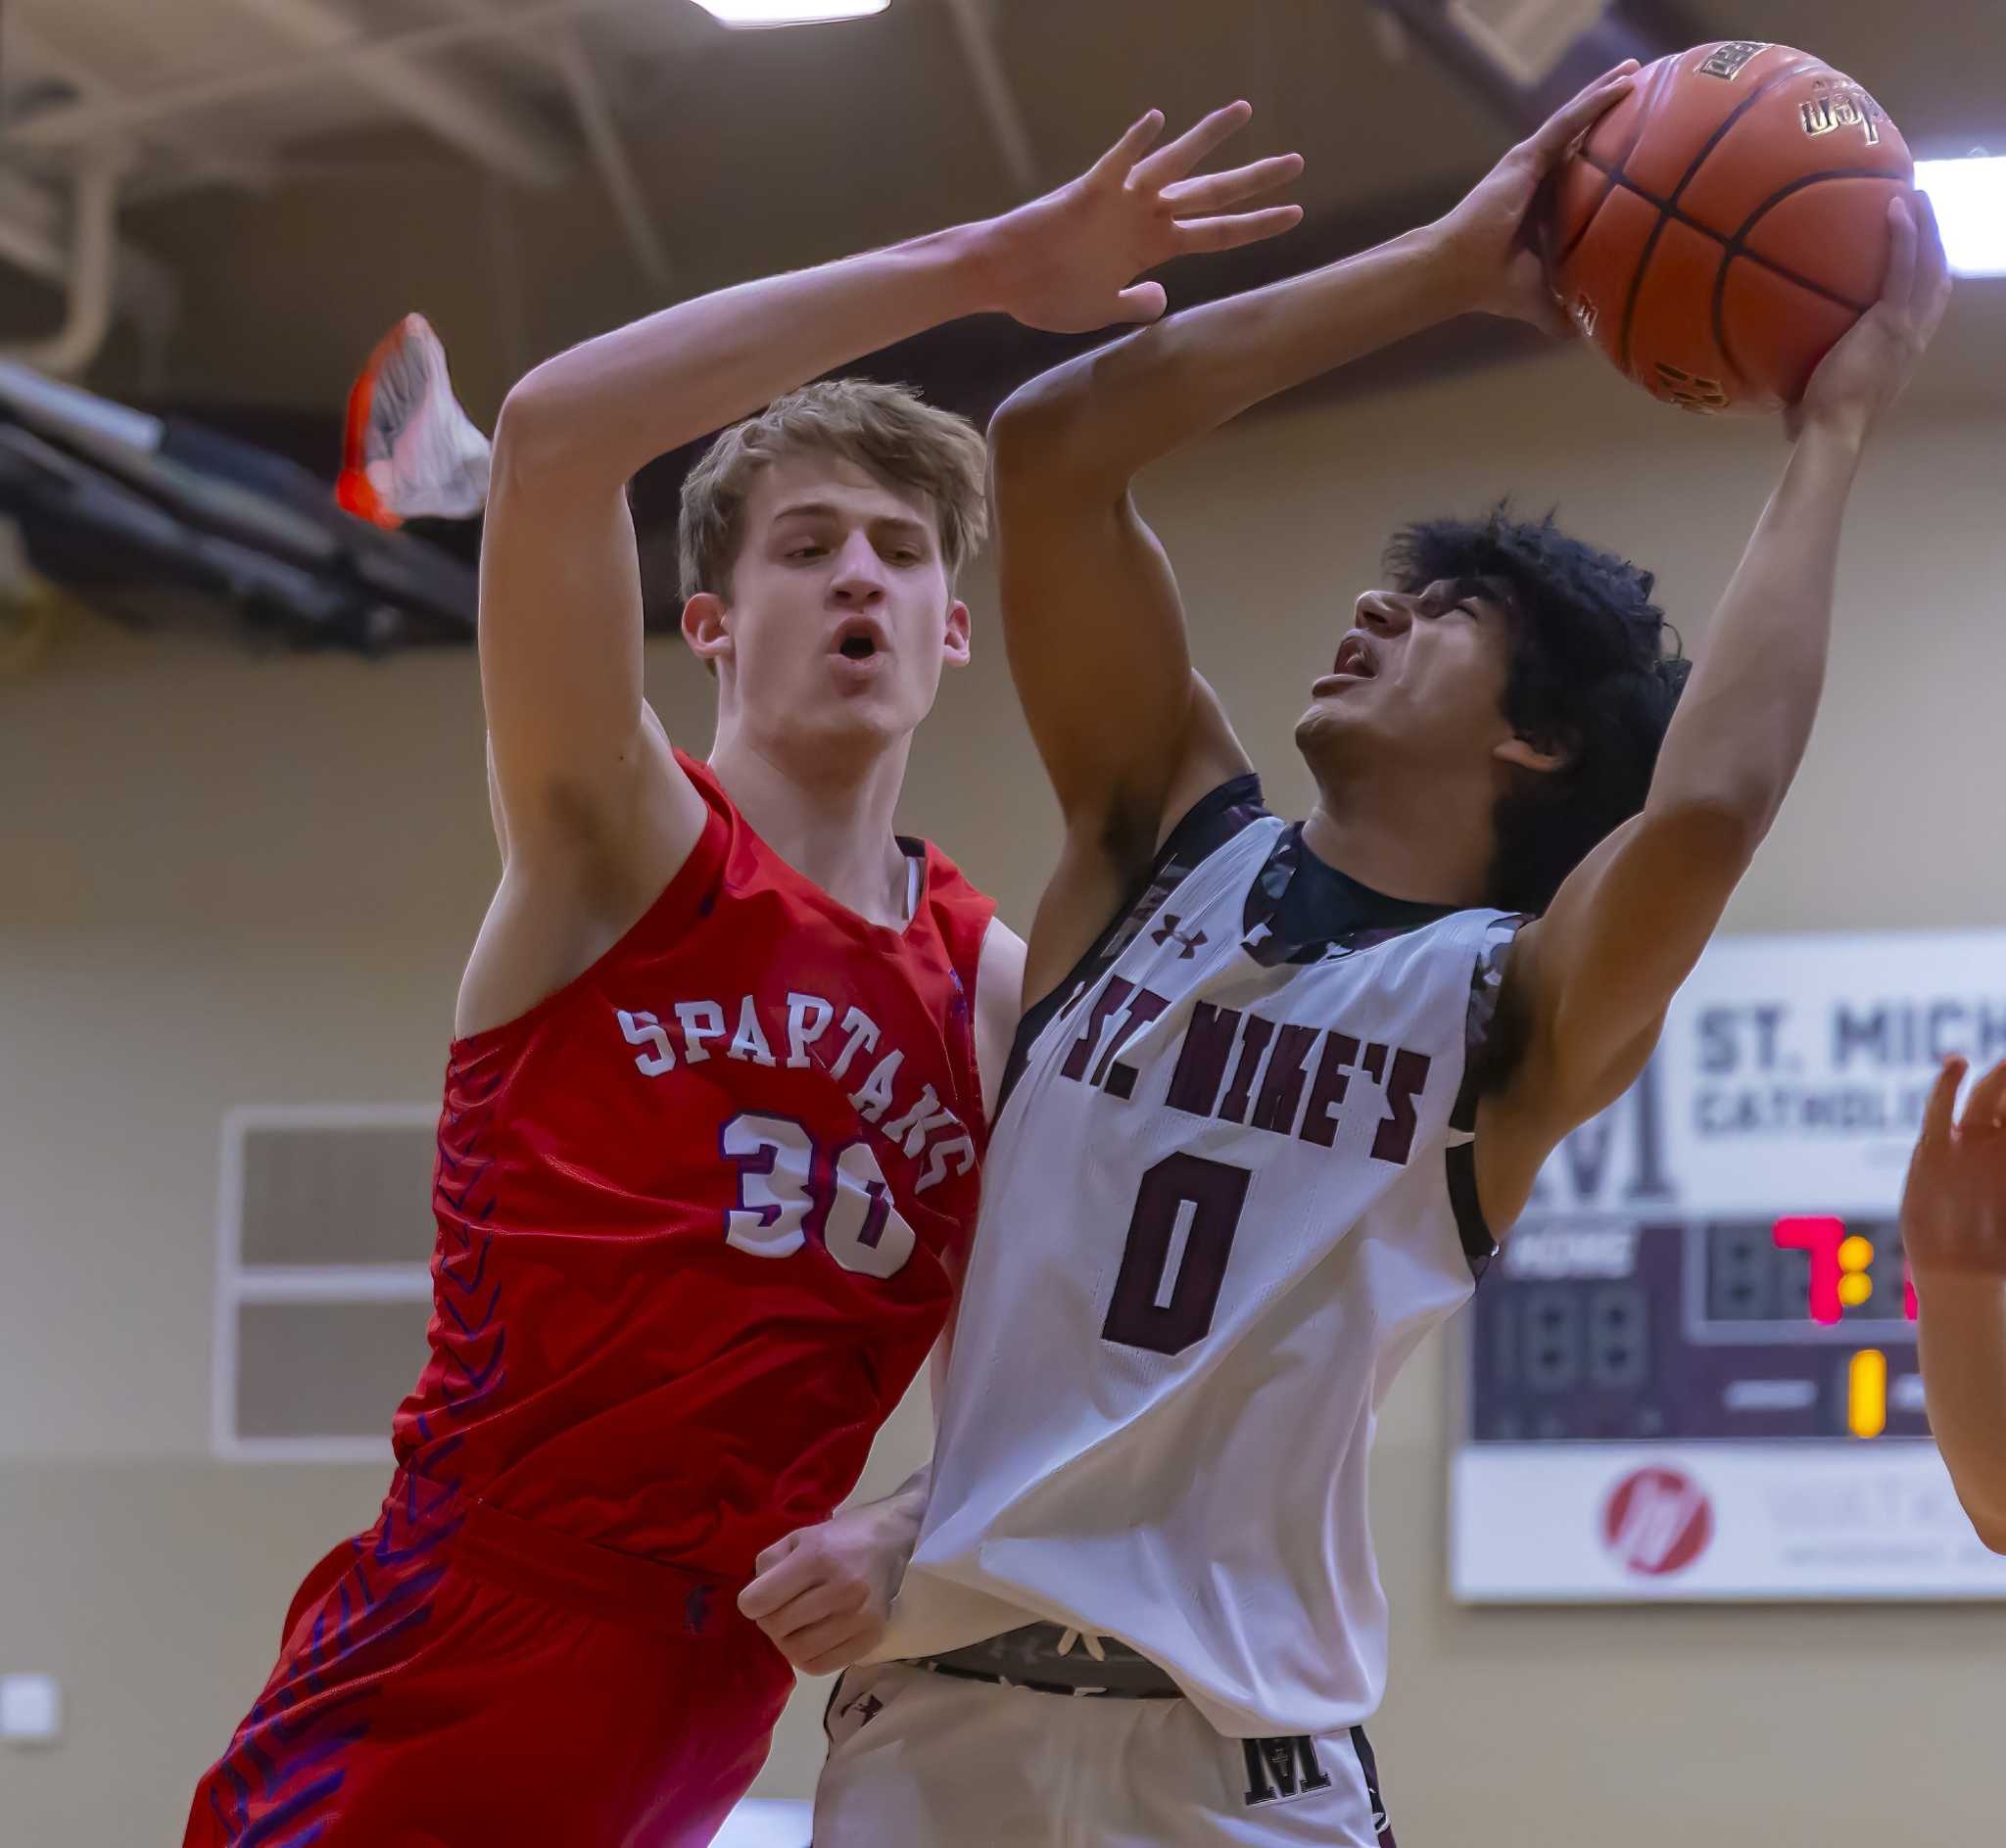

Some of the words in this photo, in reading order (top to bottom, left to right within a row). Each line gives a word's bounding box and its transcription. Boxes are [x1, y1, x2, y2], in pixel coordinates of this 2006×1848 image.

[615, 991, 977, 1196] SPARTANS
[1165, 999, 1432, 1166] MIKE'S
[720, 1110, 918, 1280] 30
[1098, 1150, 1254, 1358] 0
